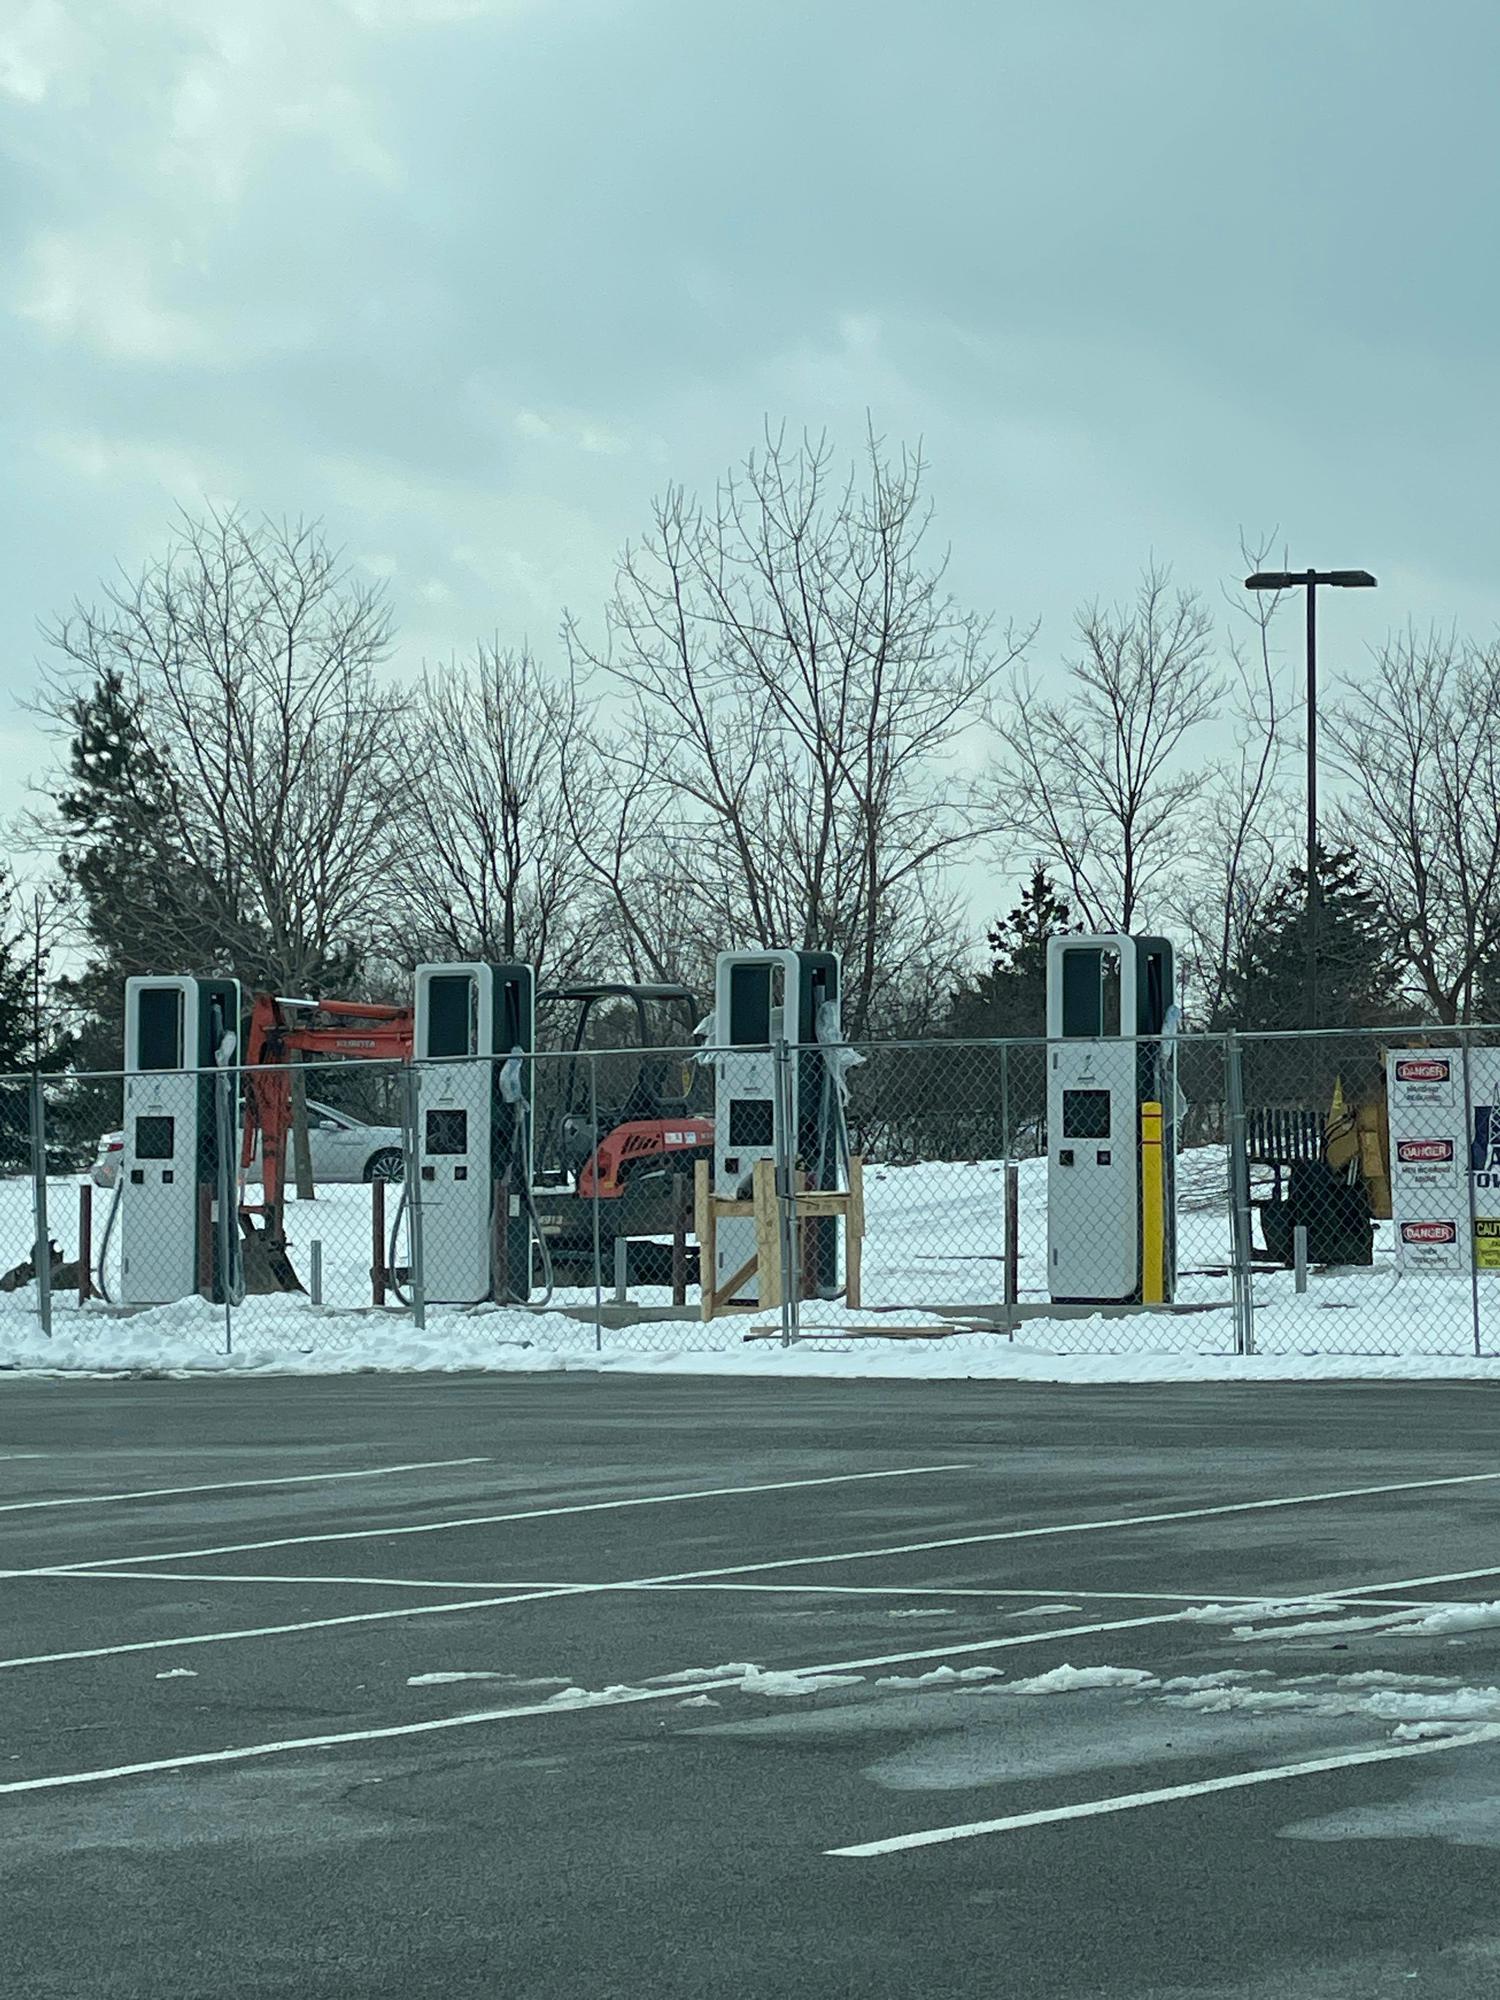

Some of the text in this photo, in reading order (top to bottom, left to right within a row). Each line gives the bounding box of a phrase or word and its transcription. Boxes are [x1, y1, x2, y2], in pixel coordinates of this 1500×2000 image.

[1402, 1066, 1443, 1077] DANGER
[1403, 1146, 1446, 1157] DANGER
[1406, 1227, 1449, 1239] DANGER
